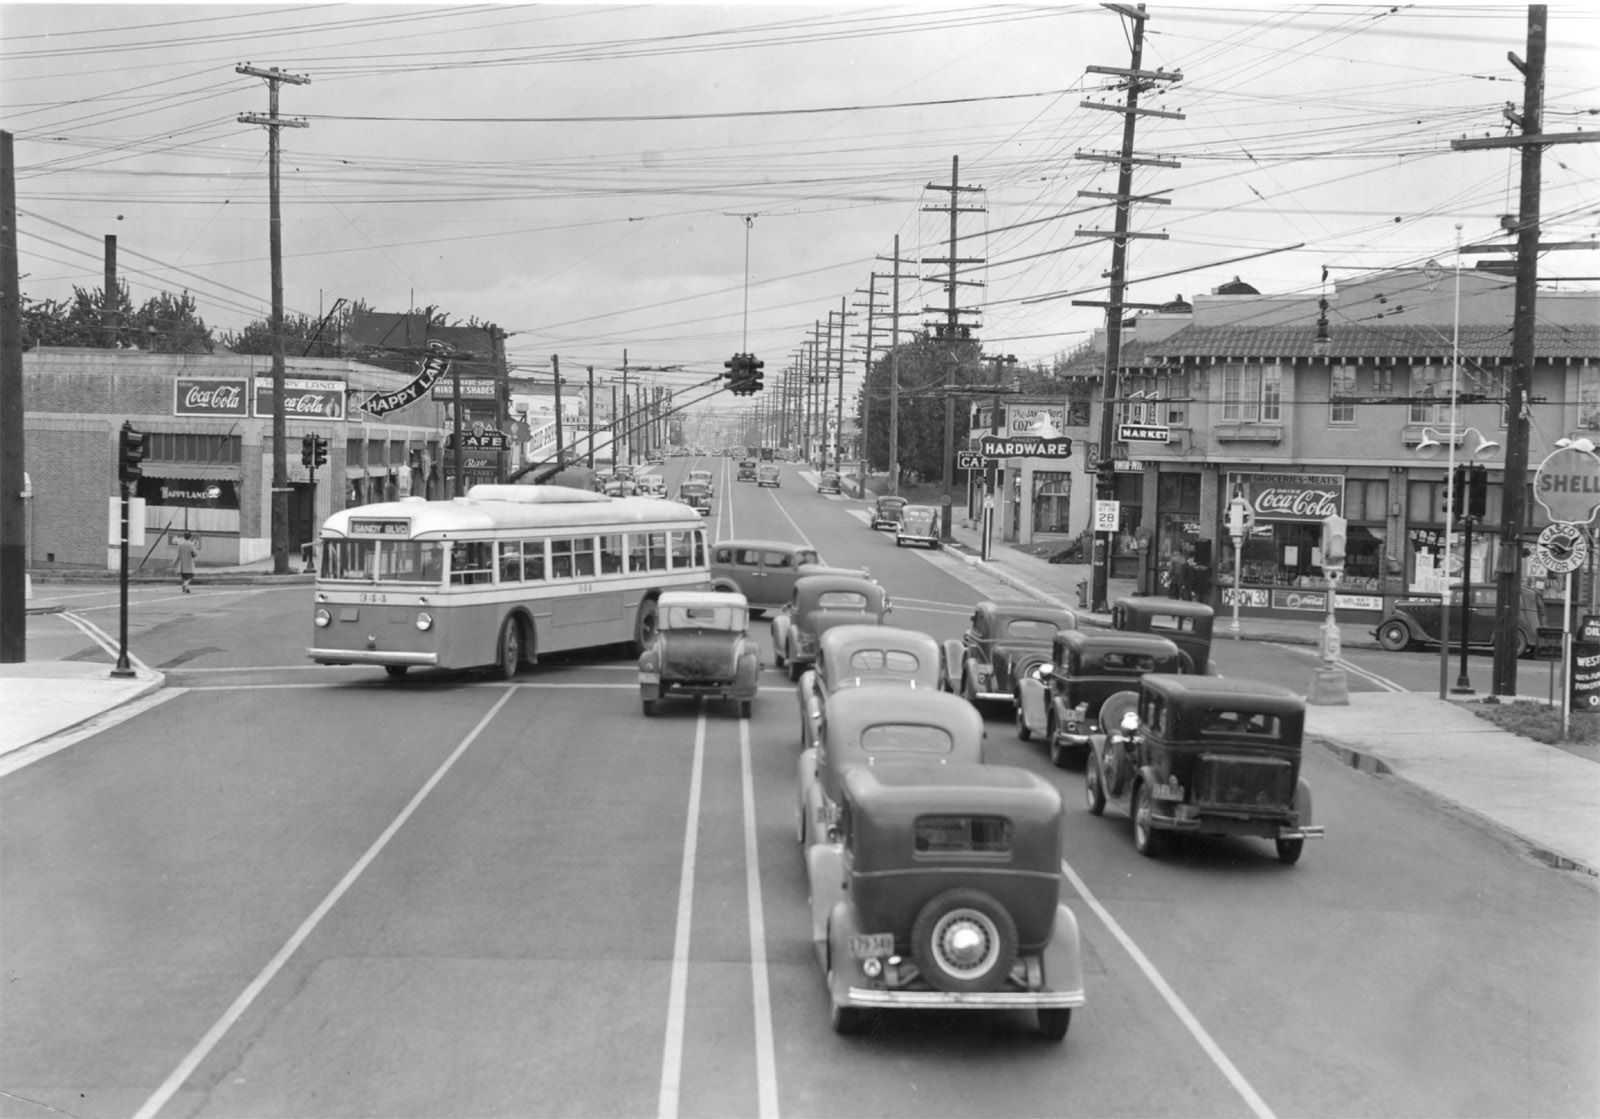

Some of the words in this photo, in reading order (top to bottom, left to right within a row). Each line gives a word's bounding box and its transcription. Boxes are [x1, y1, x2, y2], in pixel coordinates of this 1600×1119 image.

[305, 381, 336, 390] LAND
[478, 379, 495, 387] SHOP
[185, 385, 242, 408] Coca-Cola
[467, 386, 496, 395] SHADES
[285, 394, 326, 413] ca-Cola
[367, 386, 417, 412] HAPPY
[1123, 429, 1168, 439] MARKET
[985, 442, 1067, 455] HARDWARE
[961, 458, 988, 468] CAF
[1541, 473, 1600, 493] SHELL
[1254, 488, 1340, 516] Coca-Cola
[1099, 512, 1115, 523] 28
[354, 524, 381, 534] SANDY
[1542, 524, 1576, 541] GASCO
[1540, 550, 1569, 571] MOTOR
[1571, 539, 1586, 566] FUEL
[359, 593, 387, 603] 344
